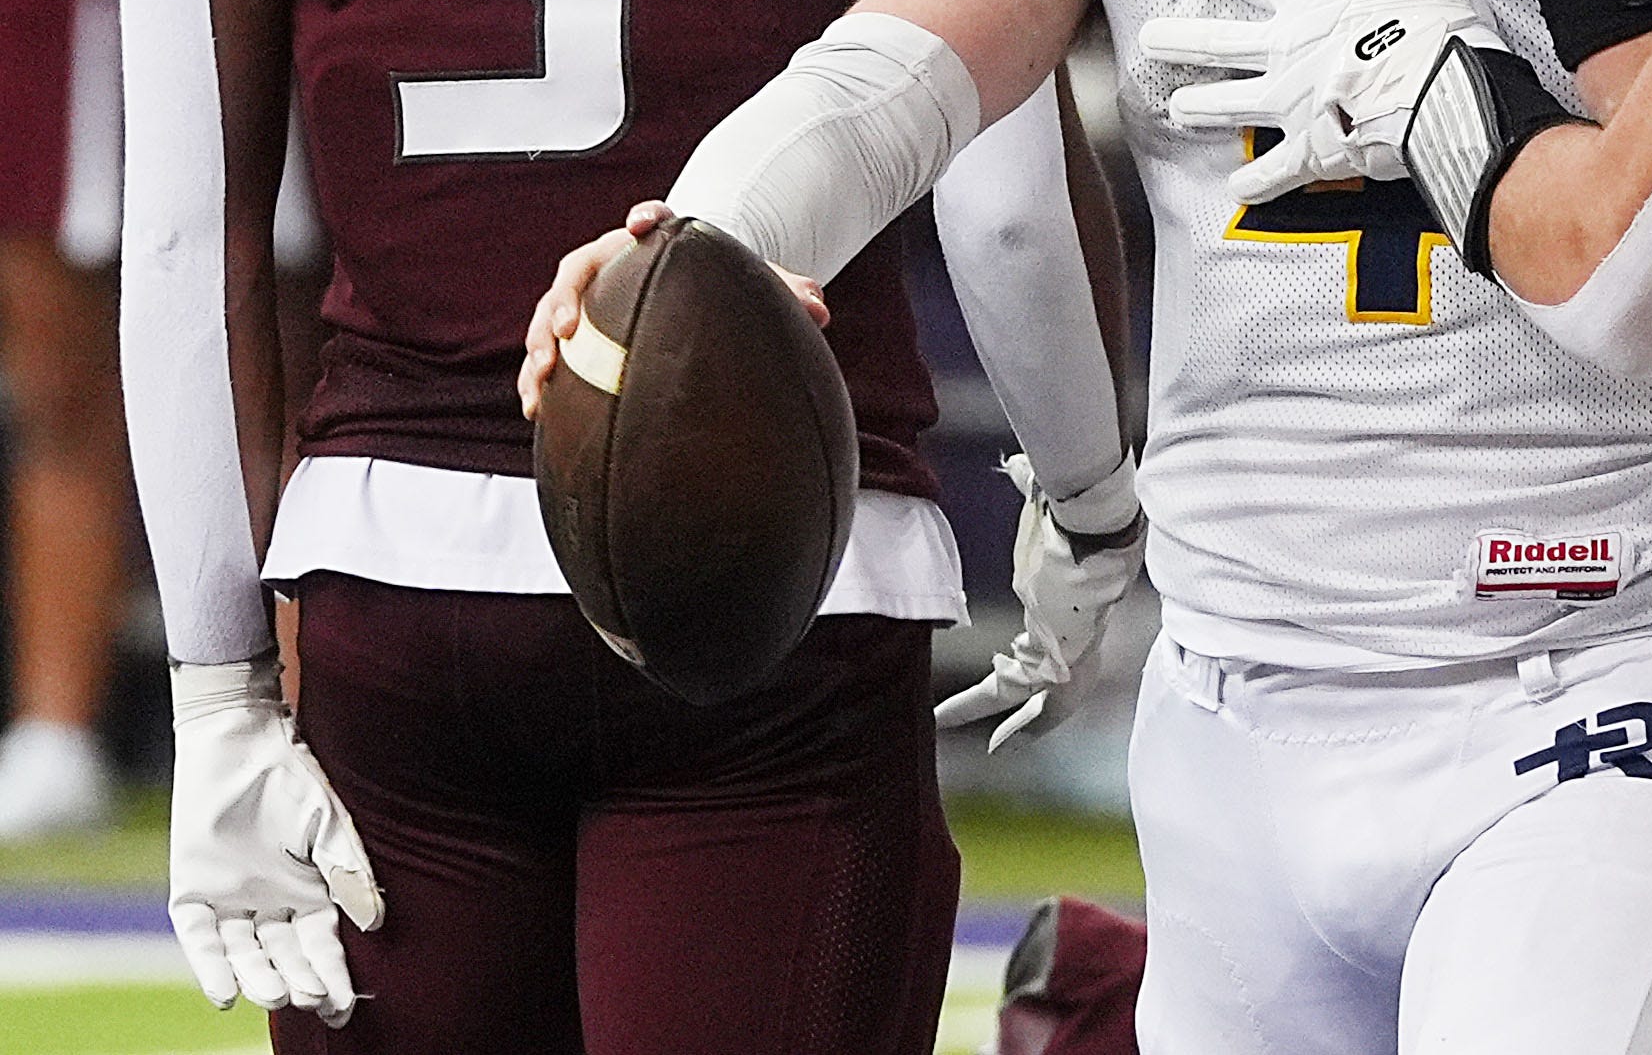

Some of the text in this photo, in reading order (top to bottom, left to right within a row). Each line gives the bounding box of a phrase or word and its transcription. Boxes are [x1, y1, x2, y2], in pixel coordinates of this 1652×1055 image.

[1489, 539, 1608, 563] Riddell
[1485, 565, 1607, 576] PROTECT AND PERFORM
